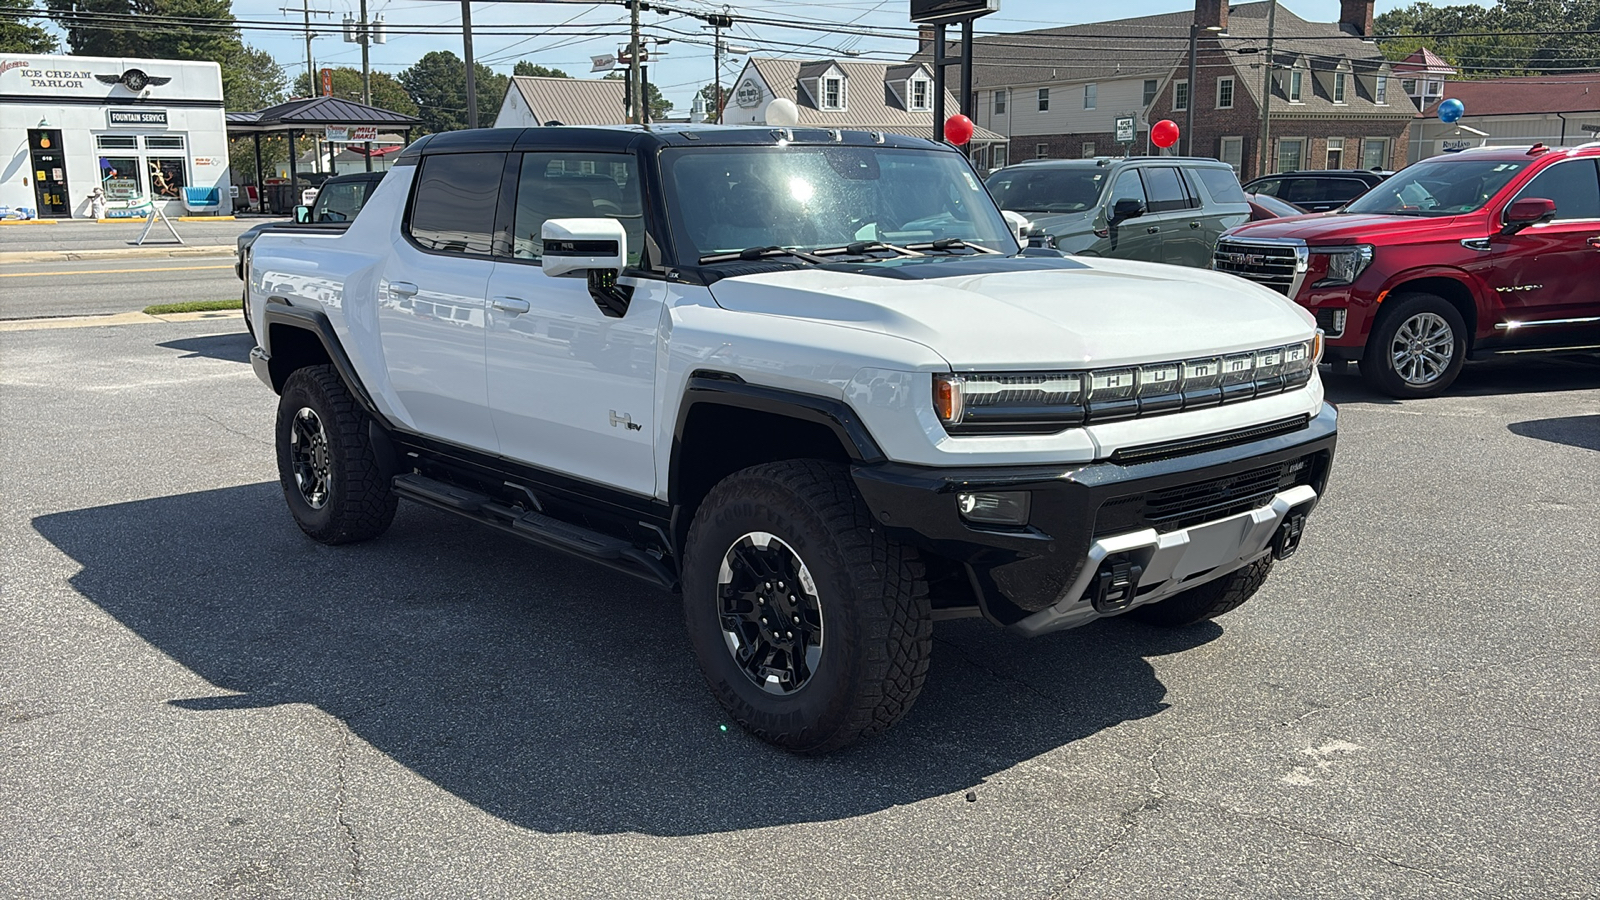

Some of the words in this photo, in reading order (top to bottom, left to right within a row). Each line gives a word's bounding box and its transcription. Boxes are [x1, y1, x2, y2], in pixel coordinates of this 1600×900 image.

[21, 69, 42, 78] ICE
[45, 70, 91, 79] CREAM
[31, 79, 83, 88] PARLOR
[112, 113, 141, 121] FOUNTAIN
[142, 113, 165, 122] SERVICE
[1229, 252, 1264, 266] GMC
[1106, 350, 1301, 388] HUMMER
[714, 502, 806, 552] GOODYEAR
